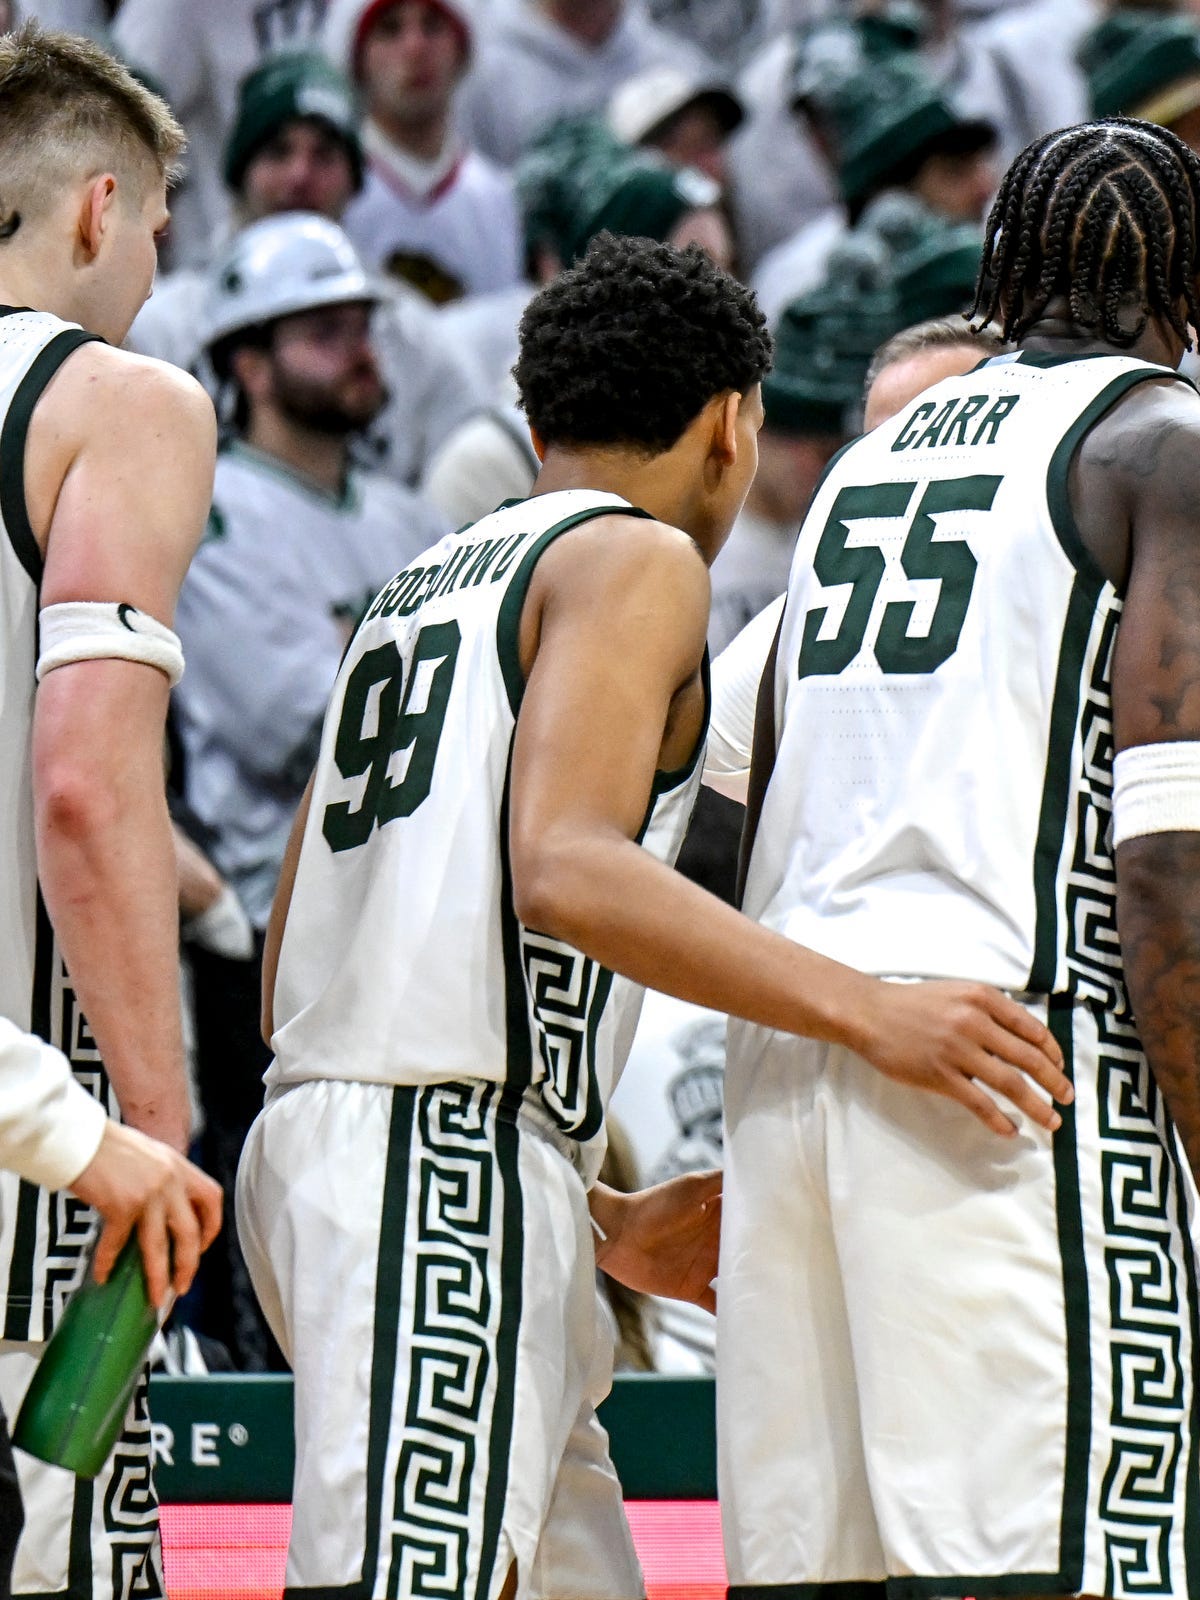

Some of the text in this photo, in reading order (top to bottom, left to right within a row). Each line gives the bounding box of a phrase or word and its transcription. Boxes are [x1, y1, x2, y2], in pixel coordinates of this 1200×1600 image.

[891, 394, 1020, 452] CARR
[798, 474, 1005, 681] 55
[322, 619, 462, 853] 99
